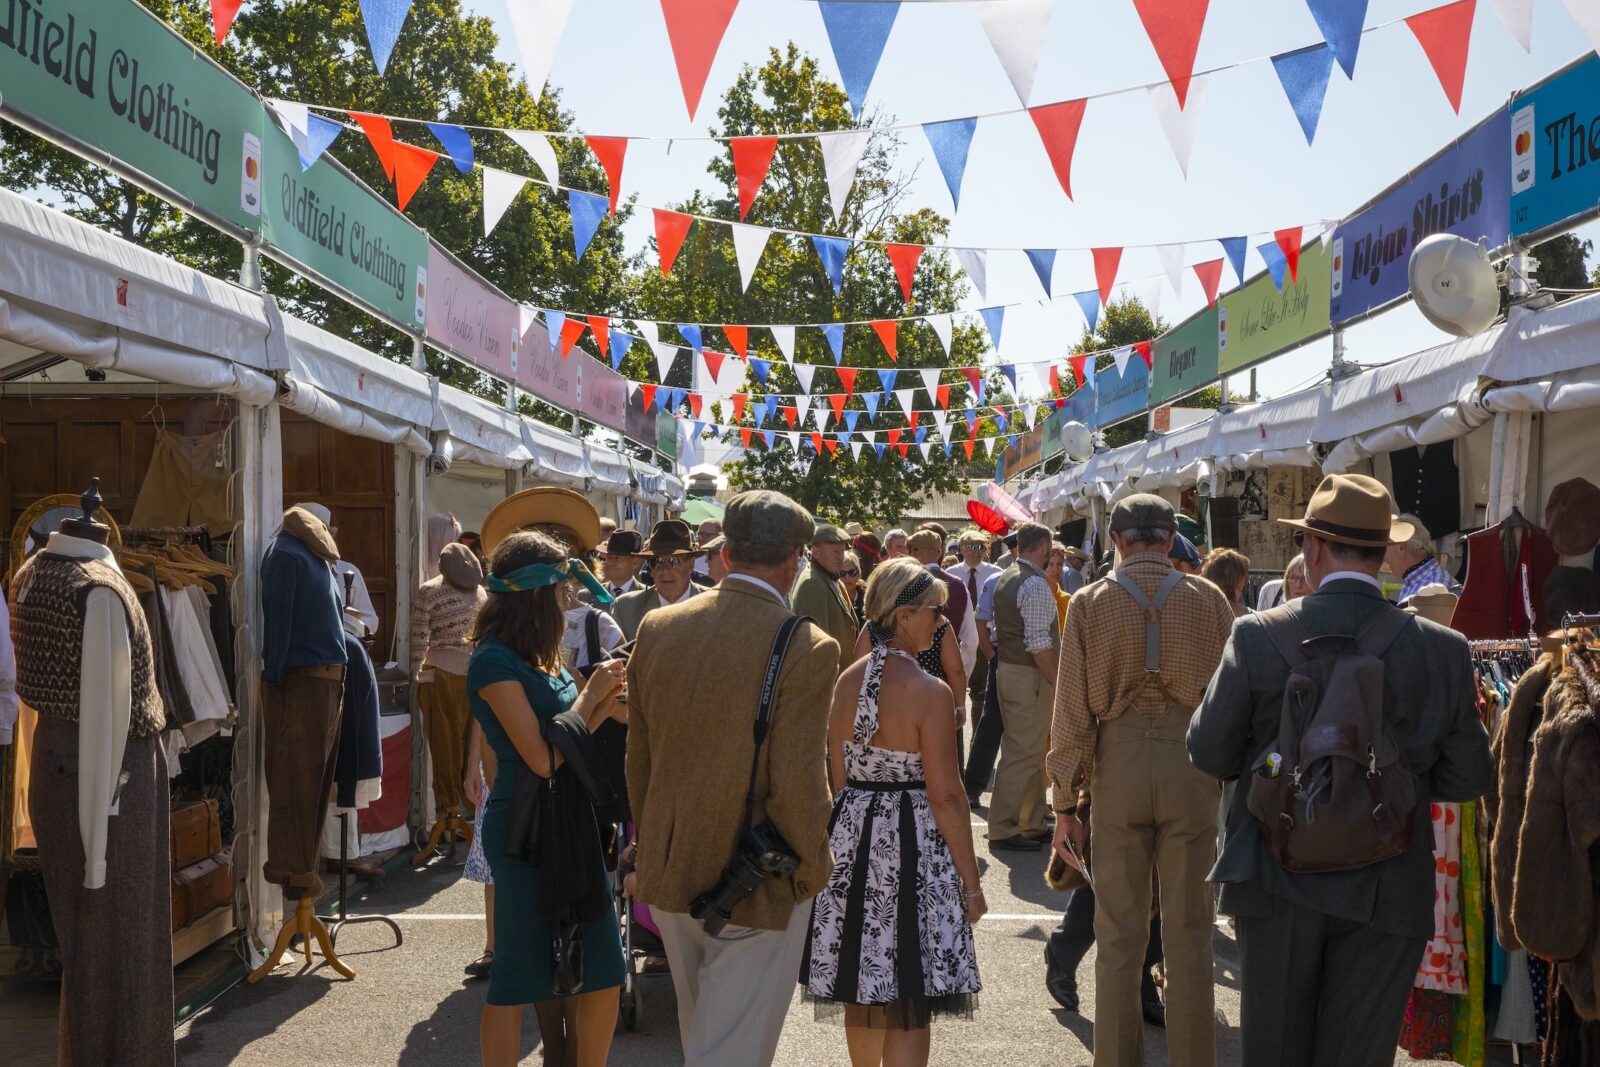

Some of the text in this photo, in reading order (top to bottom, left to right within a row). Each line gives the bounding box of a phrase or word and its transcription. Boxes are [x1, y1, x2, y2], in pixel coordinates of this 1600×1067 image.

[108, 49, 221, 185] Clothing
[282, 172, 407, 301] Oldfield Clothing
[1352, 168, 1484, 286] Elgar Shirts
[762, 654, 780, 705] OLYMPUS
